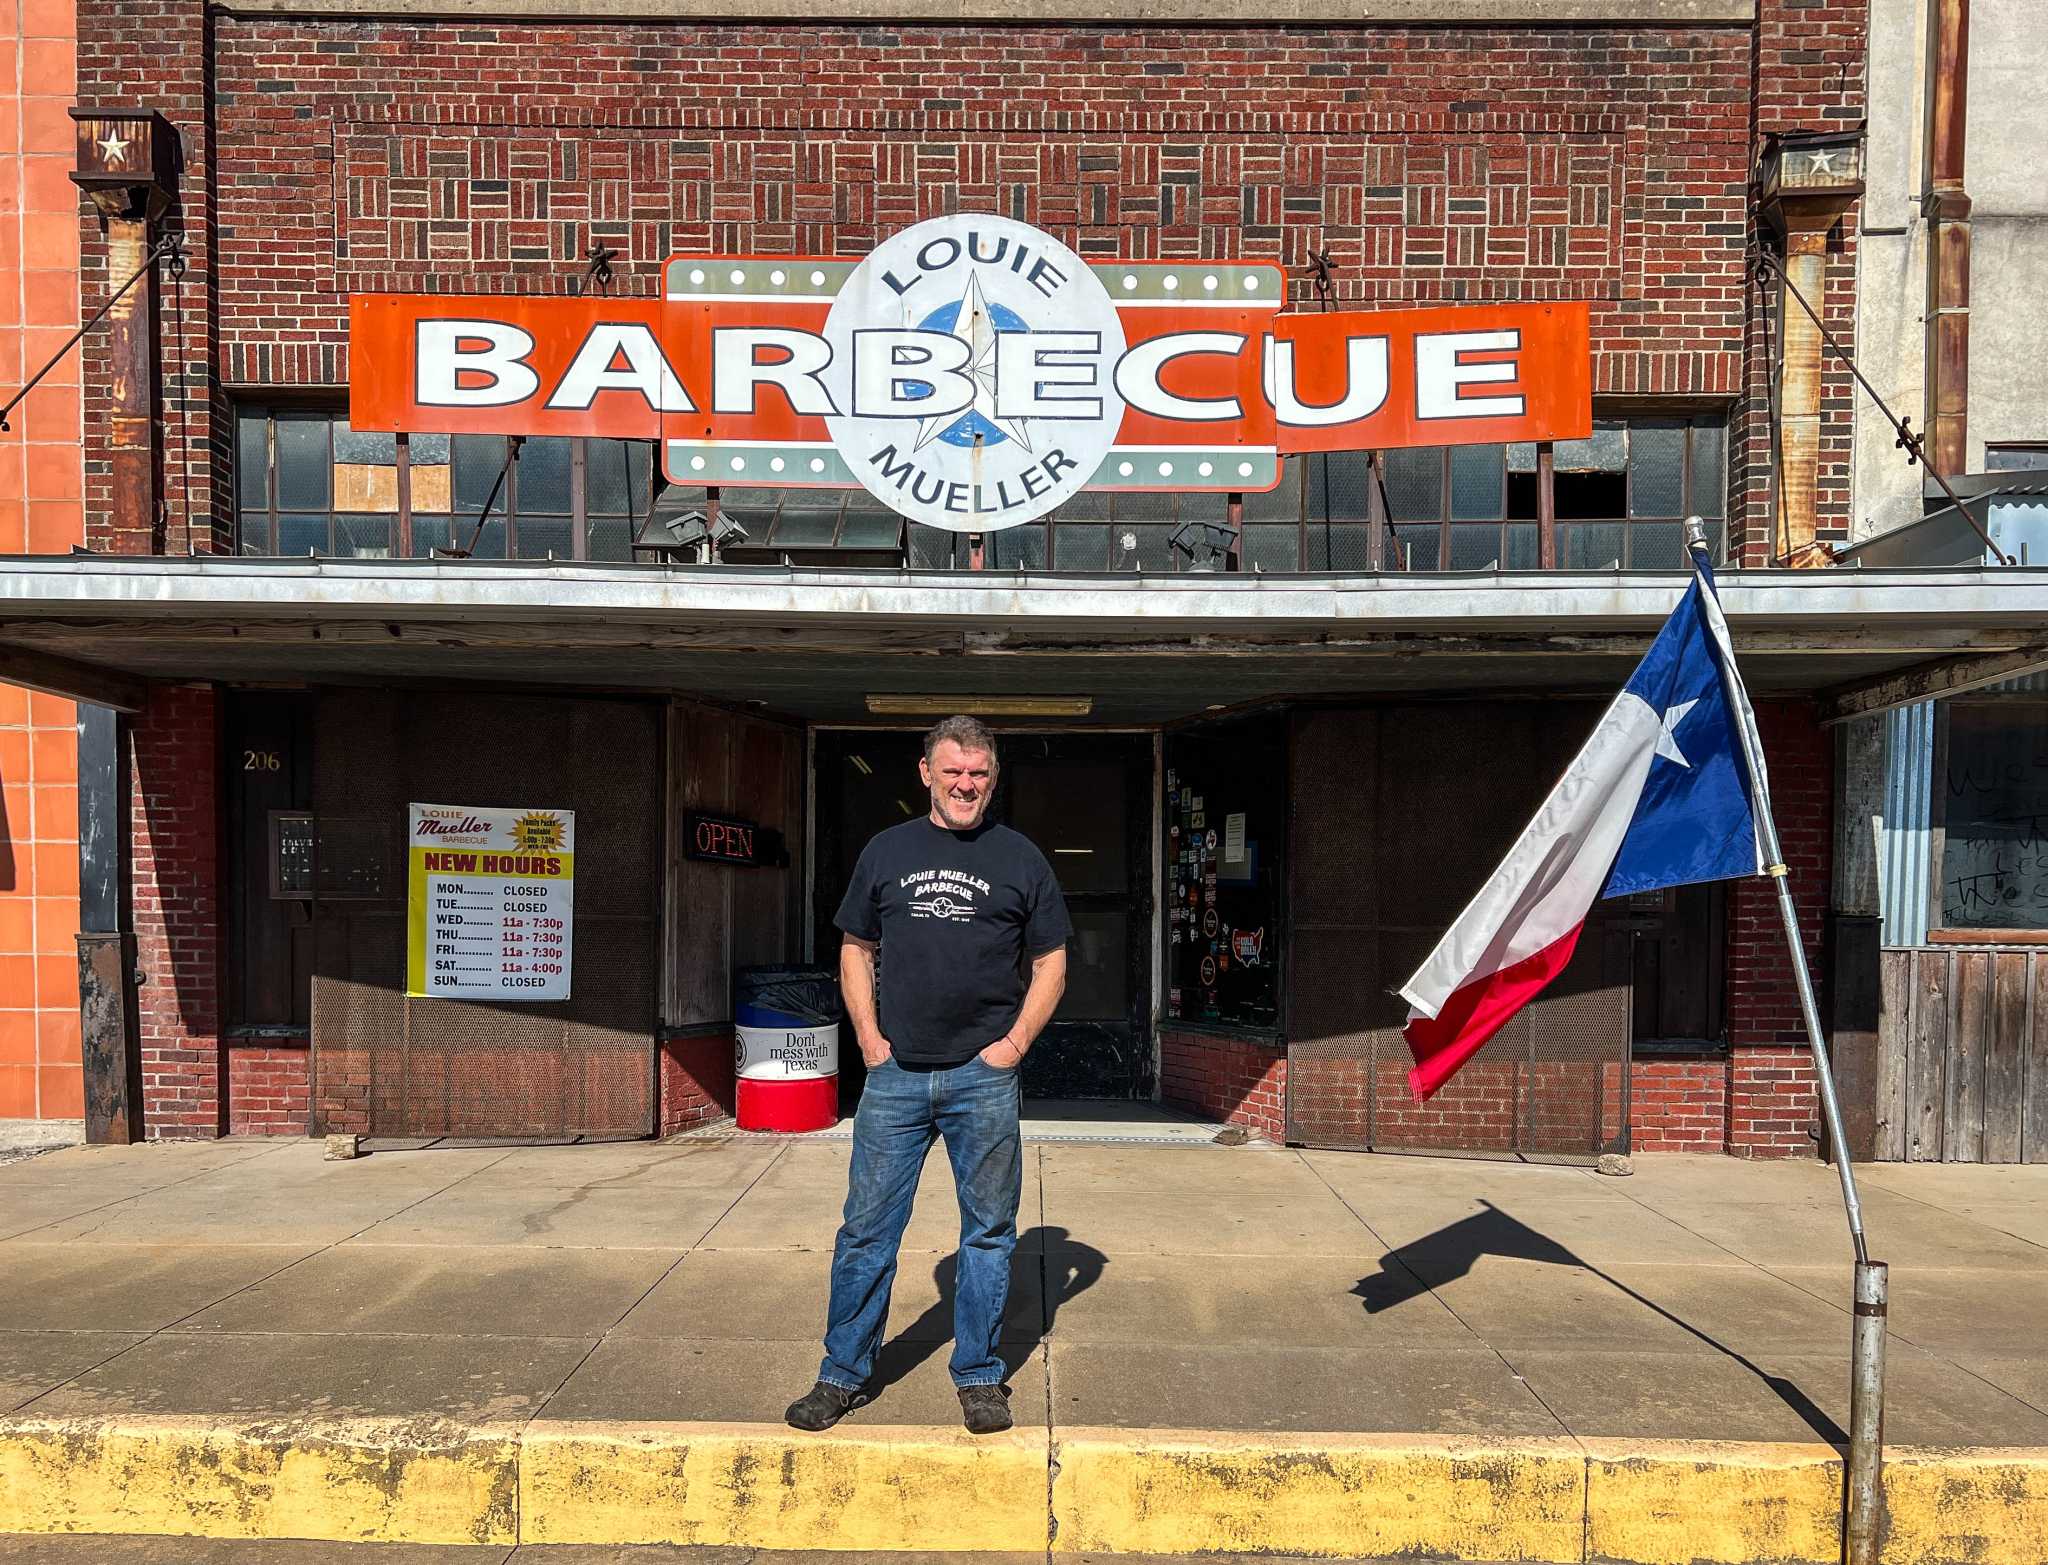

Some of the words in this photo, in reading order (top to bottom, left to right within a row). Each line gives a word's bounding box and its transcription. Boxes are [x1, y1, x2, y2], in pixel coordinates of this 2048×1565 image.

[881, 232, 1068, 298] LOUIE
[415, 318, 1526, 428] BARBECUE
[868, 444, 1078, 513] MUELLER
[243, 750, 281, 771] 206
[421, 809, 463, 819] LOUIE
[416, 817, 493, 836] Mueller
[442, 836, 488, 845] BARBECUE
[696, 822, 752, 857] OPEN
[424, 853, 477, 872] NEW
[482, 855, 561, 875] HOURS
[901, 870, 936, 888] LOUIE
[938, 869, 990, 896] MUELLER
[503, 886, 548, 896] CLOSED
[915, 882, 973, 901] BARBECUE
[503, 902, 548, 913] CLOSED
[502, 918, 524, 928] 11a
[533, 918, 563, 930] 7:30p
[502, 933, 523, 943] 11a
[533, 933, 563, 944] 7:30p
[502, 948, 523, 958] 11a
[533, 948, 563, 959] 7:30p
[501, 963, 523, 973] 11a
[532, 963, 562, 975] 4:00p
[501, 977, 546, 987] CLOSED
[786, 1032, 816, 1048] Don't
[770, 1048, 803, 1059] mess
[806, 1042, 828, 1058] with
[782, 1059, 819, 1074] Texas
